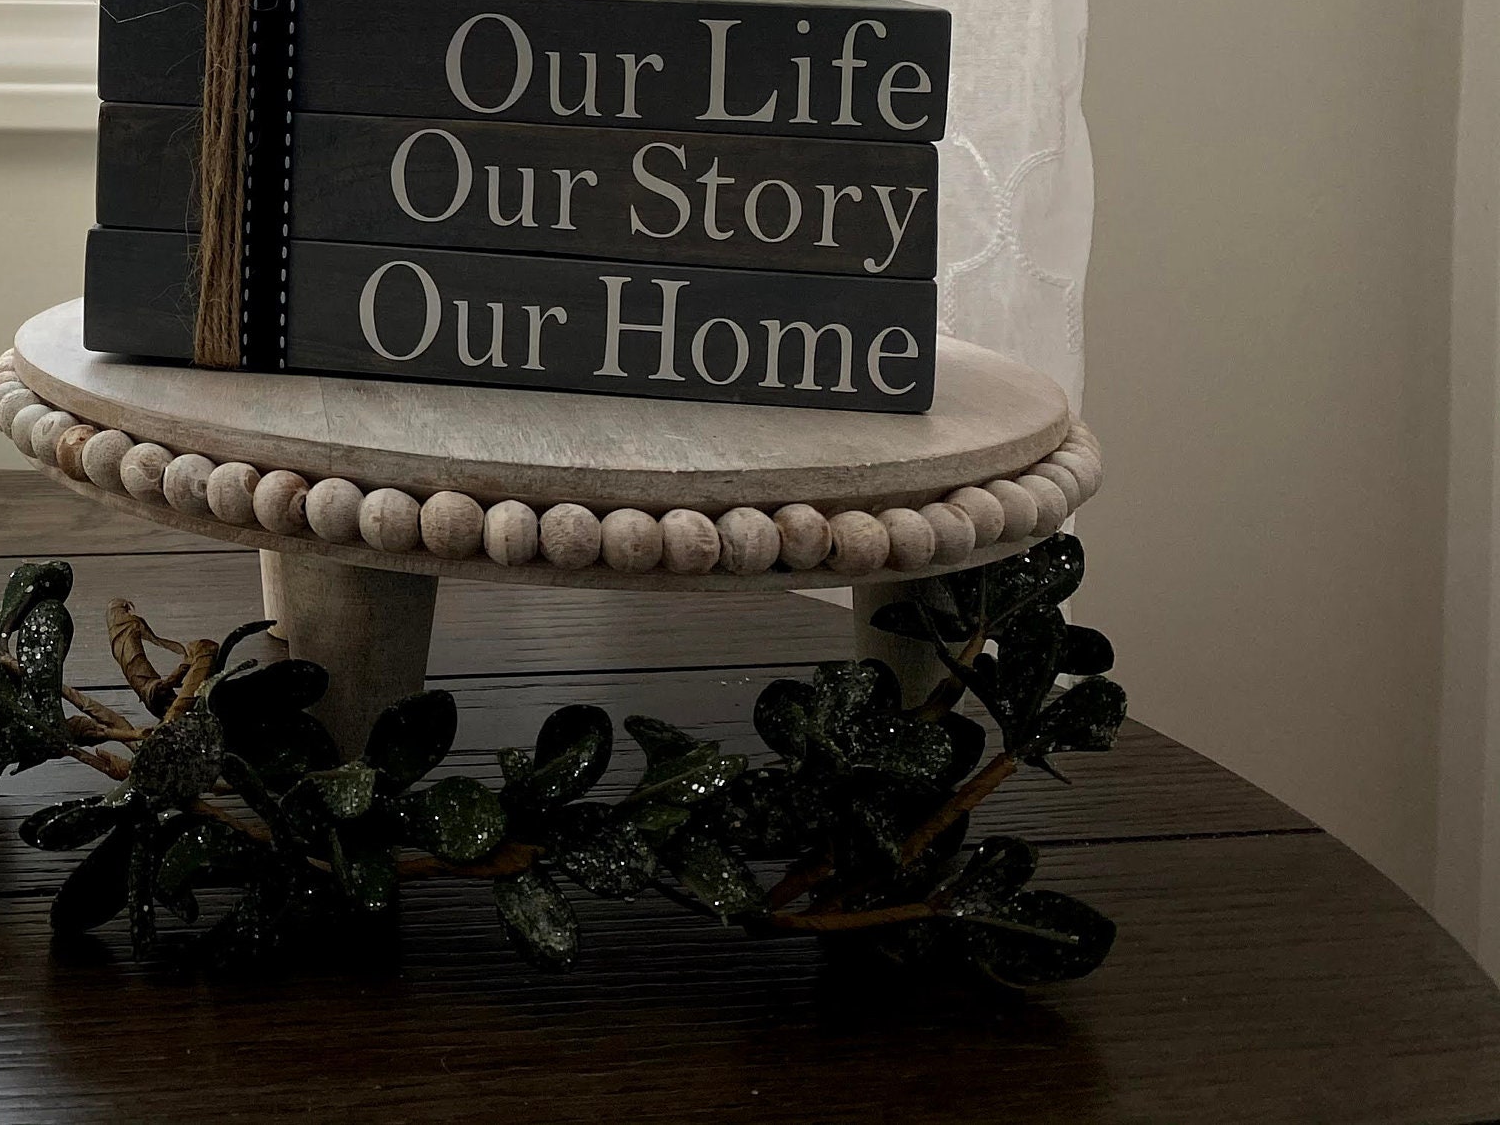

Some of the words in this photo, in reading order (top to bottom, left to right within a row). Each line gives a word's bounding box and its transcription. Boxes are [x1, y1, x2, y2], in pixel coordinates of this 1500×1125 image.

[445, 13, 664, 118] Our
[696, 19, 932, 131] Life
[390, 128, 597, 230] Our
[629, 142, 928, 273] Story
[359, 260, 568, 370] Our
[594, 275, 919, 395] Home
